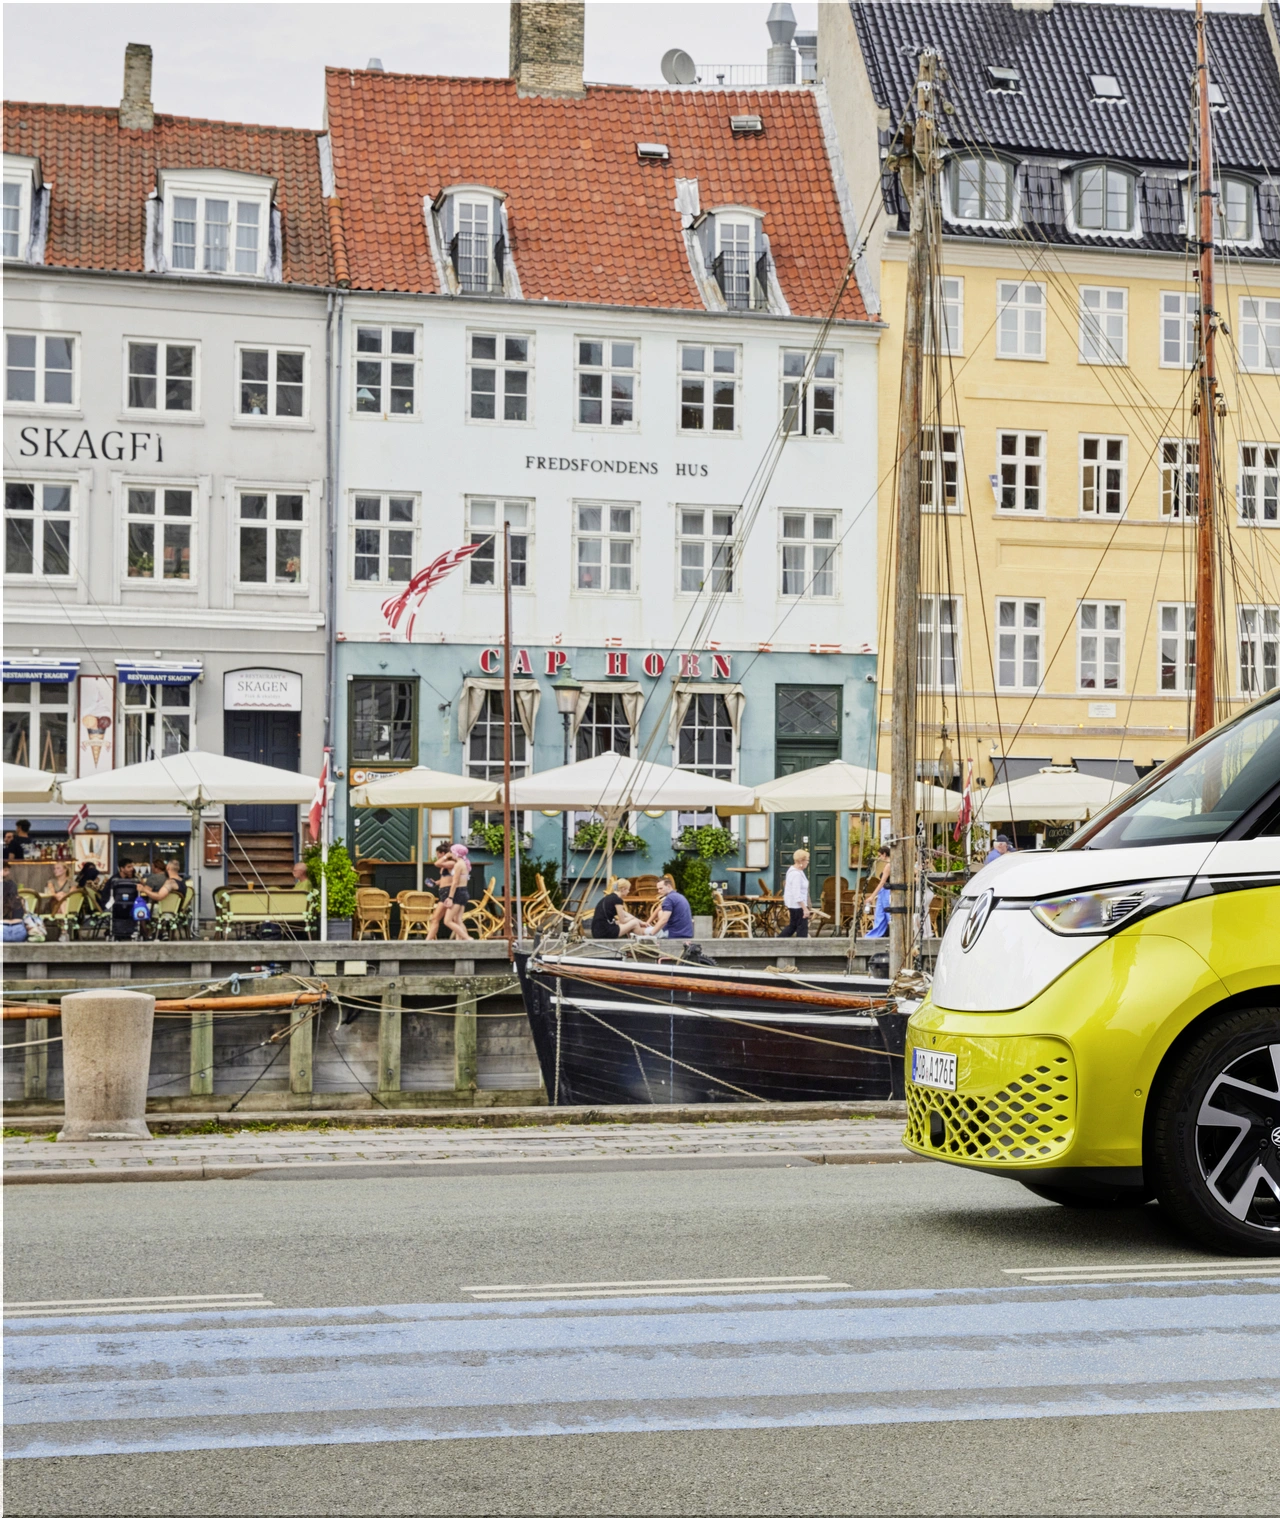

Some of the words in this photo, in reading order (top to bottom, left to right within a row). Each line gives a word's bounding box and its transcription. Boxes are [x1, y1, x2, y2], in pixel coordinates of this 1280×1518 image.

[525, 455, 659, 475] FREDSFONDENS
[675, 462, 709, 477] HUS
[479, 648, 567, 676] CAP
[604, 651, 732, 678] HORN
[3, 671, 43, 680] RESTAURANT
[44, 672, 69, 680] SKAGEN
[127, 673, 167, 681] RESTAURANT
[237, 680, 288, 692] SKAGEN
